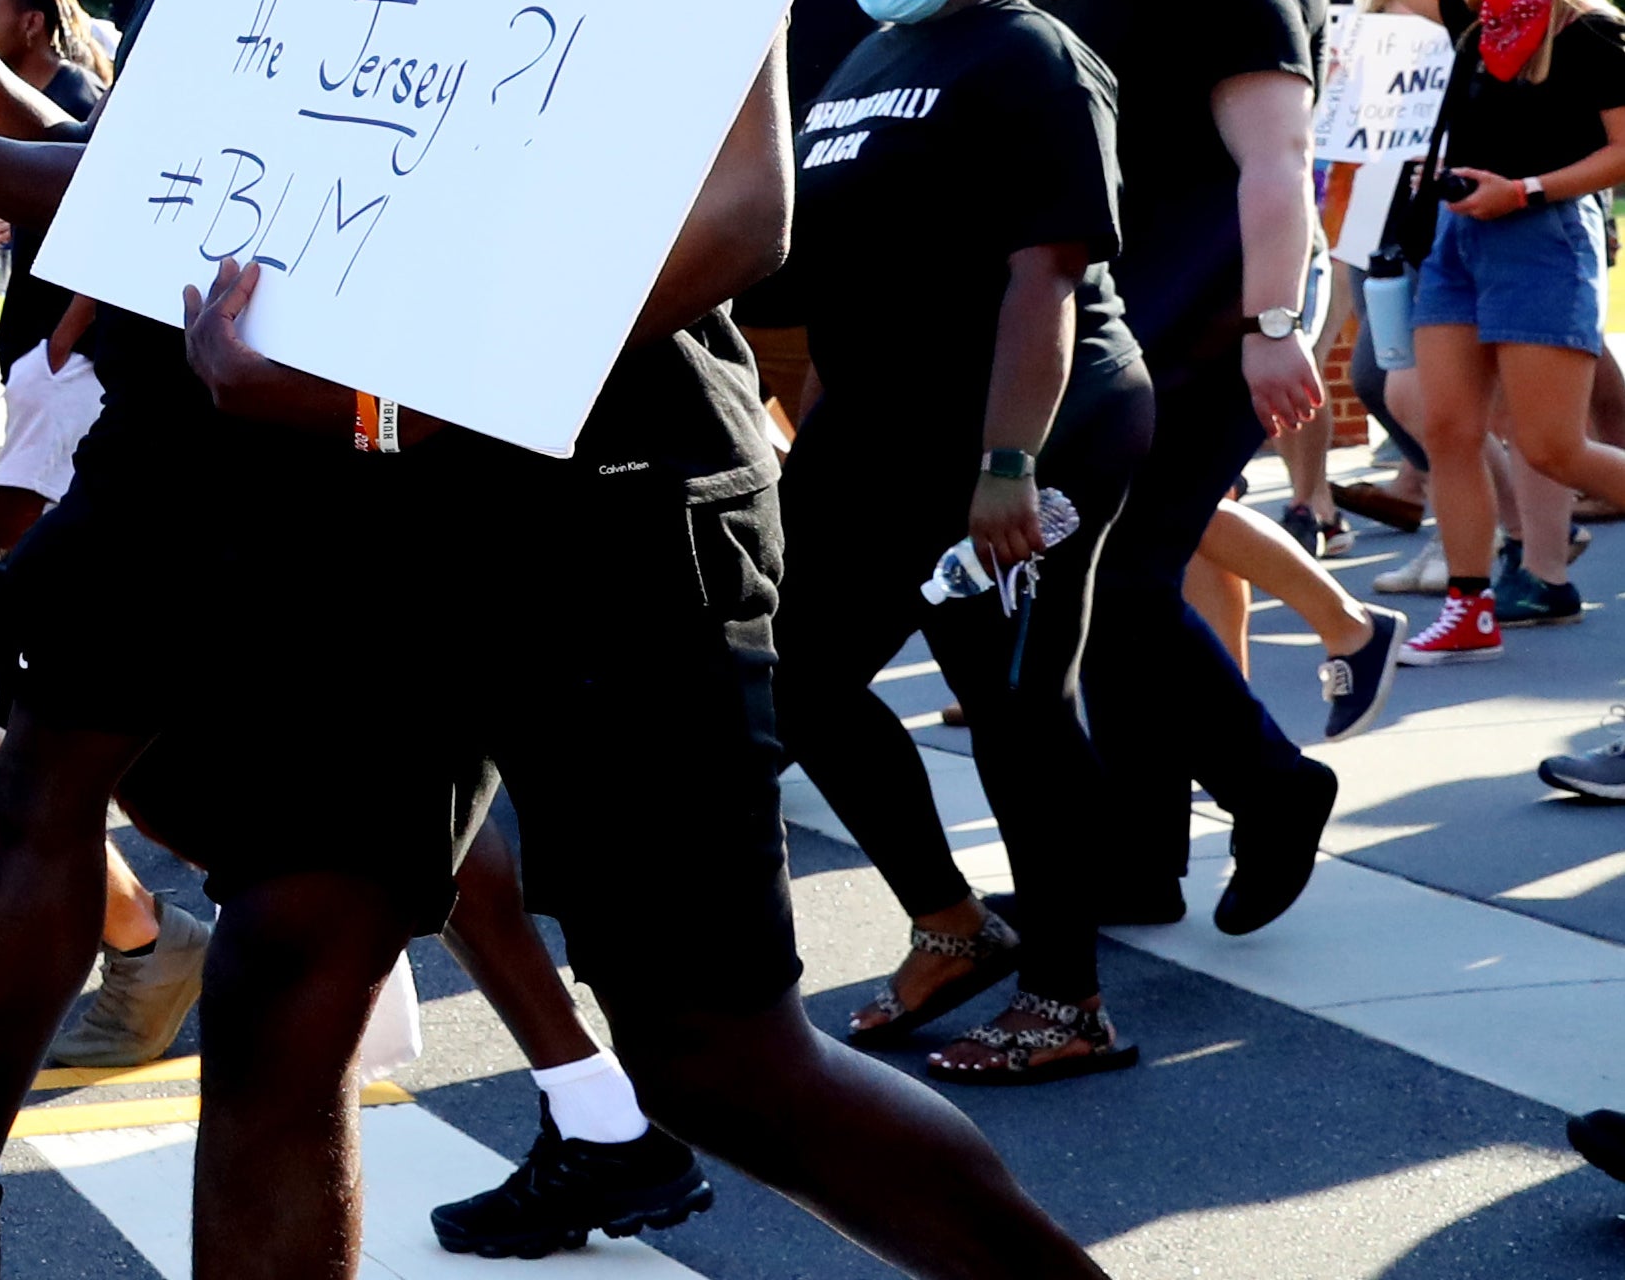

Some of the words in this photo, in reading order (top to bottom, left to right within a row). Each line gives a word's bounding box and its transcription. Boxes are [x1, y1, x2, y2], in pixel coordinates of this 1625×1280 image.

[1387, 66, 1446, 95] ANG
[802, 130, 871, 169] BLACK
[148, 148, 391, 297] #BLM
[383, 401, 395, 440] HUMBL
[599, 463, 627, 475] Calvin
[627, 460, 650, 471] Klein
